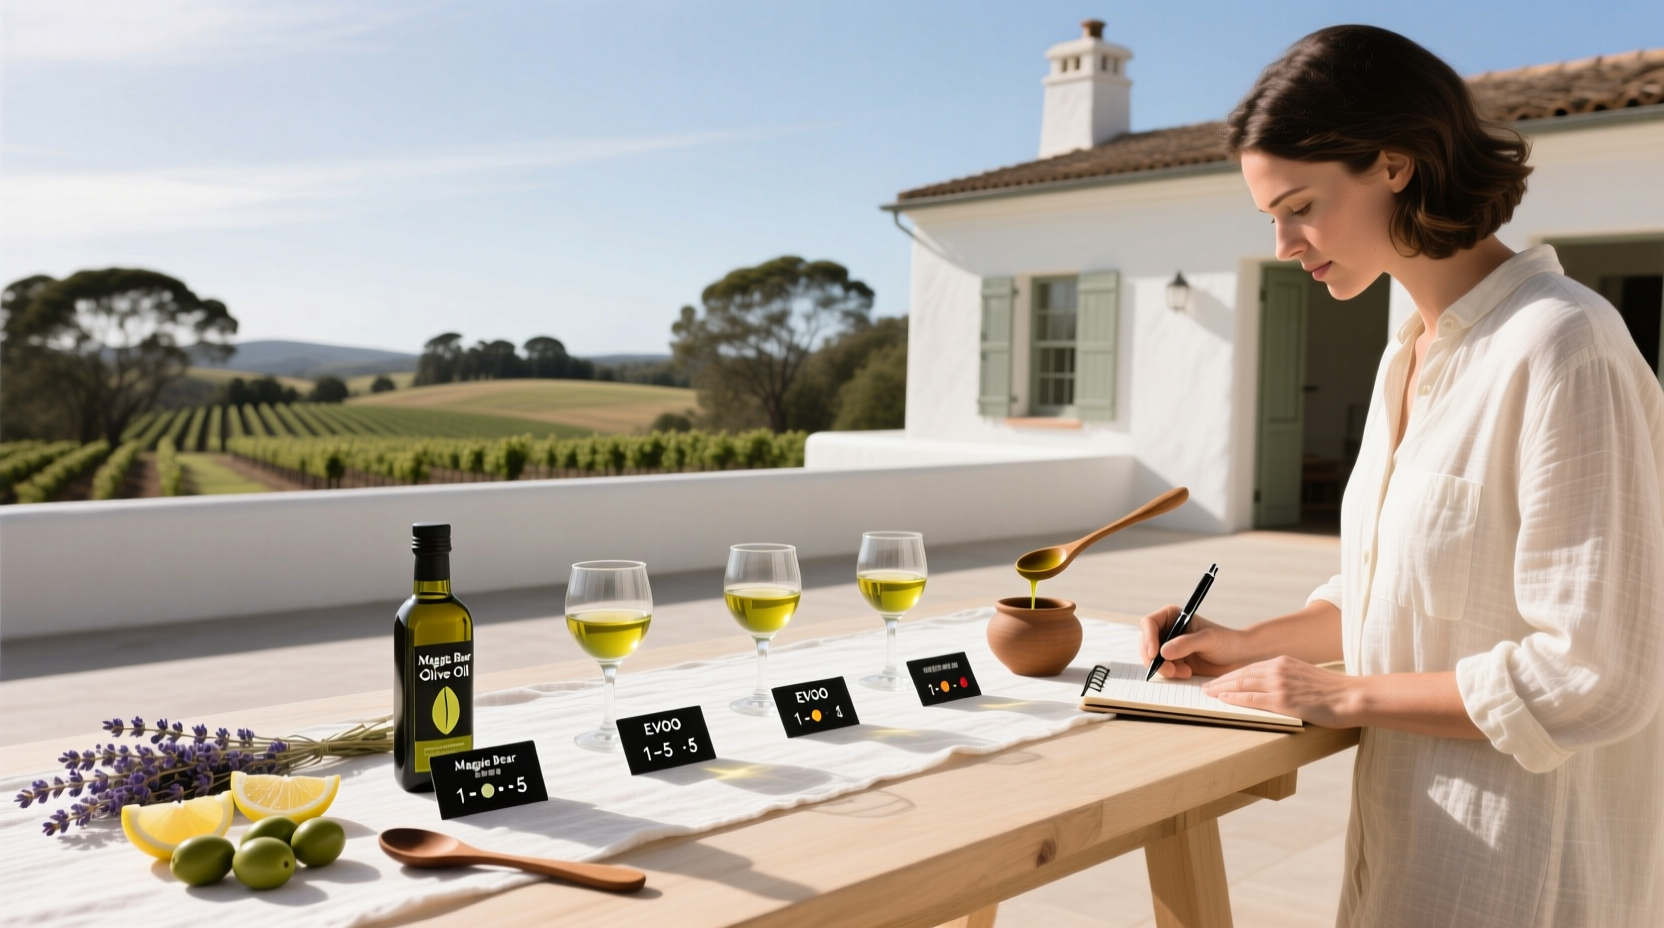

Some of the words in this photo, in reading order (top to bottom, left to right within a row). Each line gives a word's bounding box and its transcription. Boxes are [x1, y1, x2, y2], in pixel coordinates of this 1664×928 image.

[419, 668, 451, 681] Olive
[795, 687, 828, 703] EVOO
[643, 718, 681, 736] EVOO
[643, 742, 673, 761] 1-5
